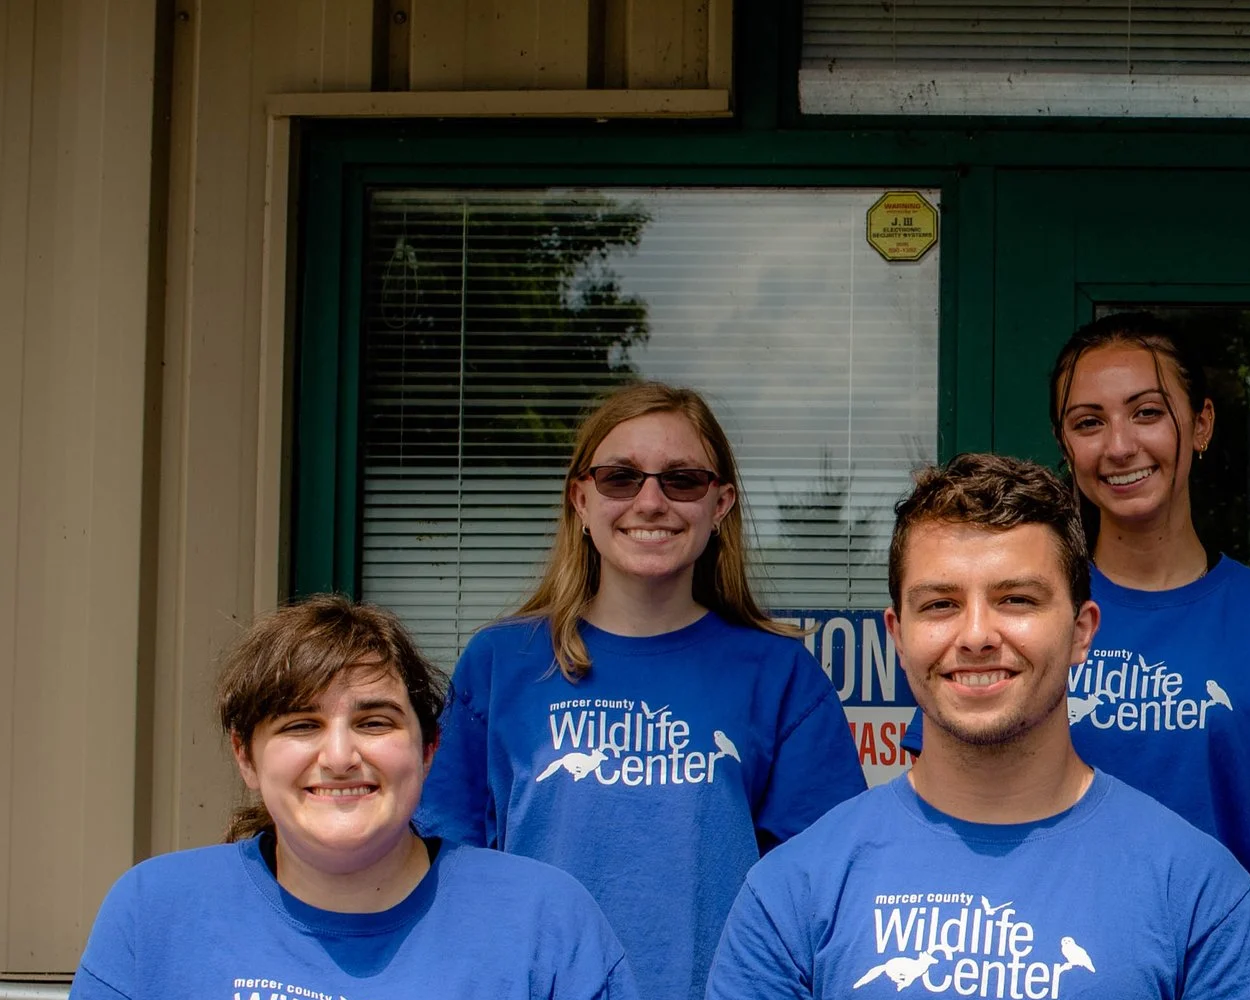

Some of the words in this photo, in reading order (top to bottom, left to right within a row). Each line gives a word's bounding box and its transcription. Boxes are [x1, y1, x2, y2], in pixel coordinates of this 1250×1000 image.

[775, 617, 896, 702] ION
[1093, 649, 1132, 661] county
[550, 699, 592, 711] mercer
[595, 698, 635, 711] county
[1090, 690, 1211, 732] Center
[550, 710, 690, 752] Wildlife
[849, 722, 917, 766] ASK
[595, 744, 716, 786] Center
[874, 893, 923, 904] mercer
[927, 892, 973, 905] county
[874, 907, 1034, 957] Wildlife
[234, 978, 283, 989] mercer
[922, 945, 1066, 999] Center
